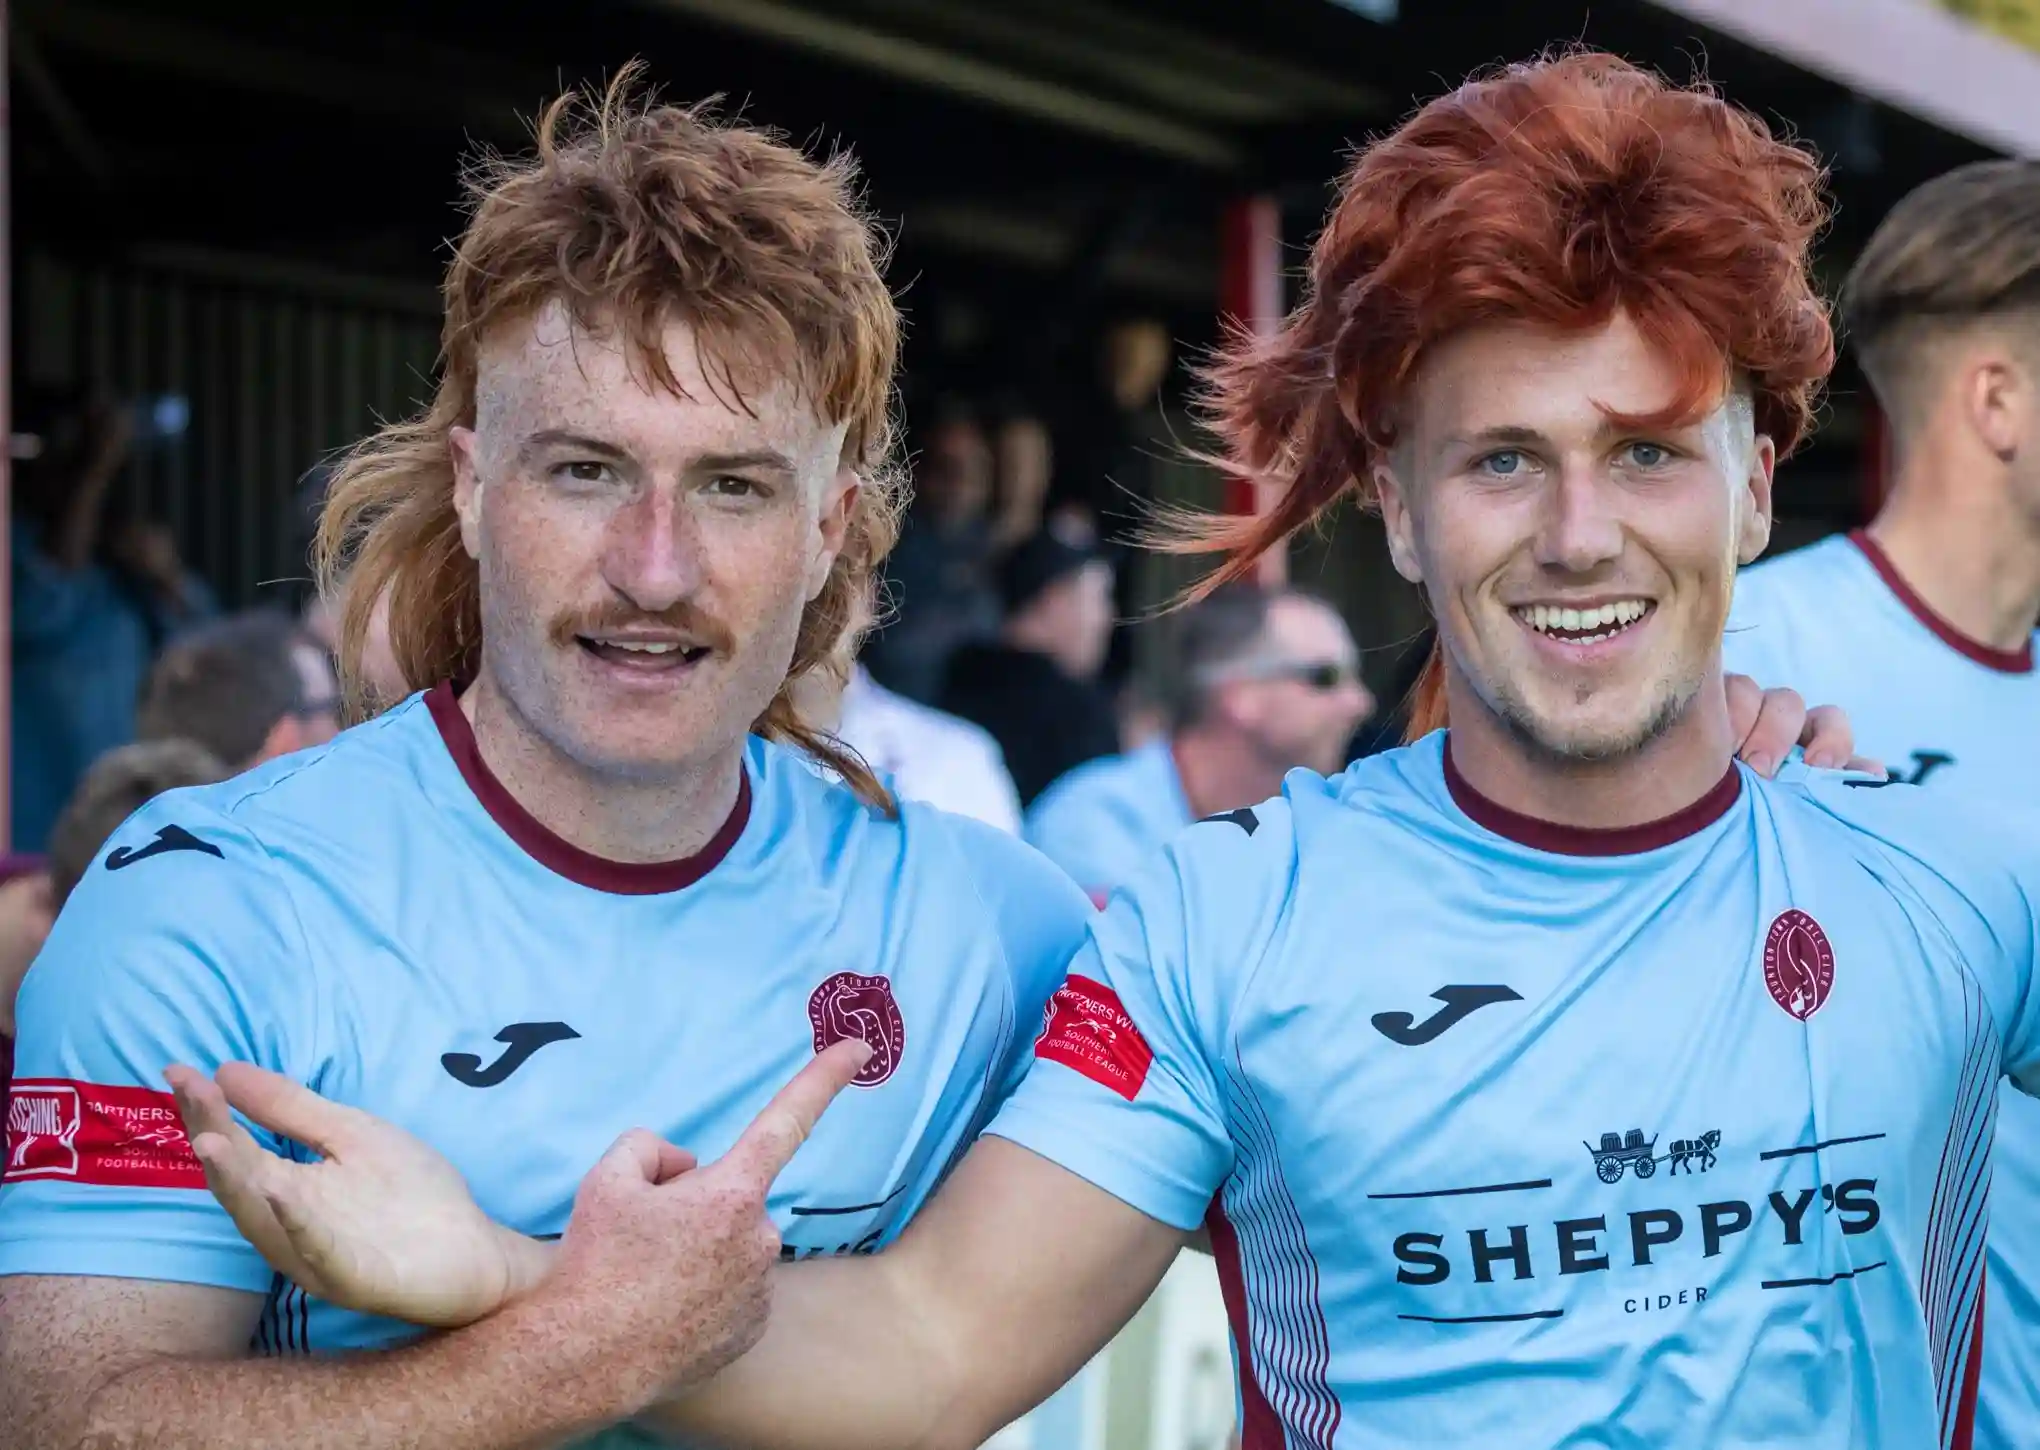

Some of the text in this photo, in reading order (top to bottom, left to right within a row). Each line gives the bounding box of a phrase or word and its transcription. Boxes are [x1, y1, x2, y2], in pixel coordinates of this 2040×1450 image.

[1087, 1052, 1129, 1080] LEAGUE
[96, 1157, 164, 1170] FOOTBALL
[1392, 1178, 1881, 1285] SHEPPY'S
[1624, 1287, 1709, 1314] CIDER
